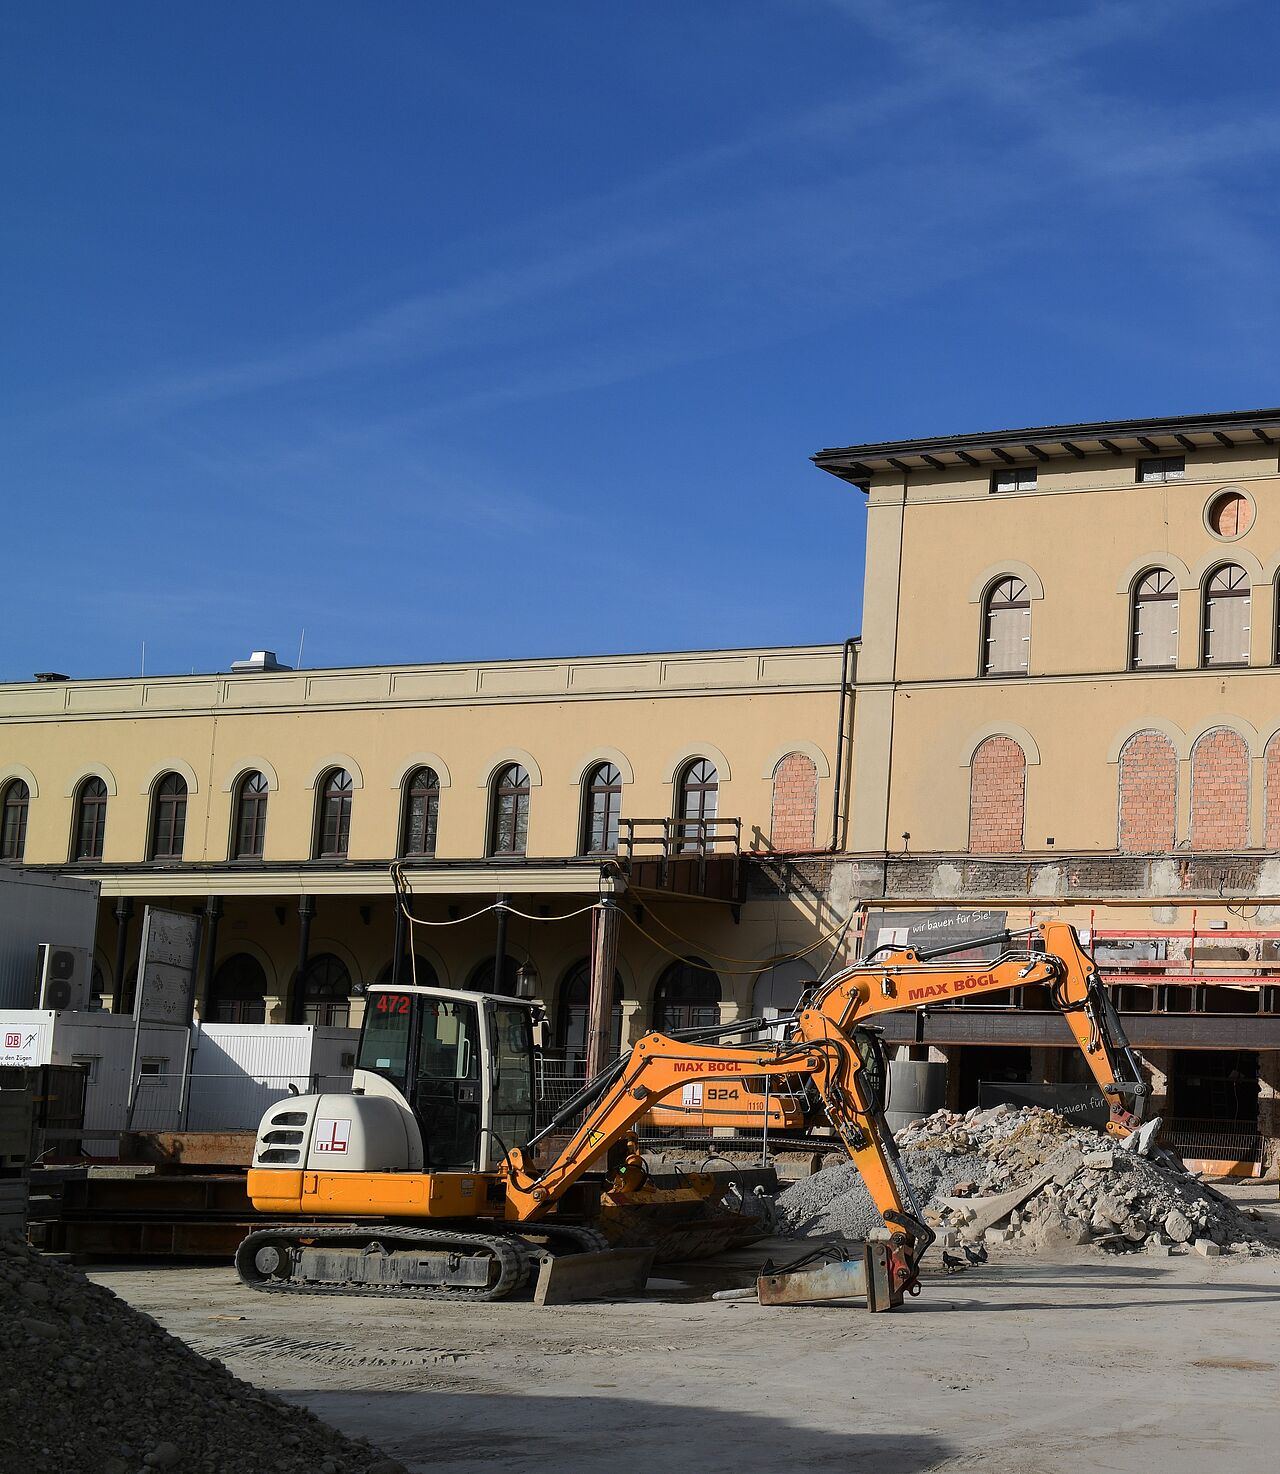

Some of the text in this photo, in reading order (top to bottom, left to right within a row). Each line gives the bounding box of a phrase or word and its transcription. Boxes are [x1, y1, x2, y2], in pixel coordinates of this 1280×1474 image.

[912, 924, 925, 933] wir
[927, 919, 954, 930] bauen
[956, 914, 970, 923] für
[908, 974, 999, 1001] MAX BÖGL
[376, 995, 411, 1014] 472
[7, 1035, 20, 1046] DB
[673, 1063, 704, 1072] MAX
[708, 1089, 739, 1100] 924
[1056, 1097, 1105, 1115] bauen für
